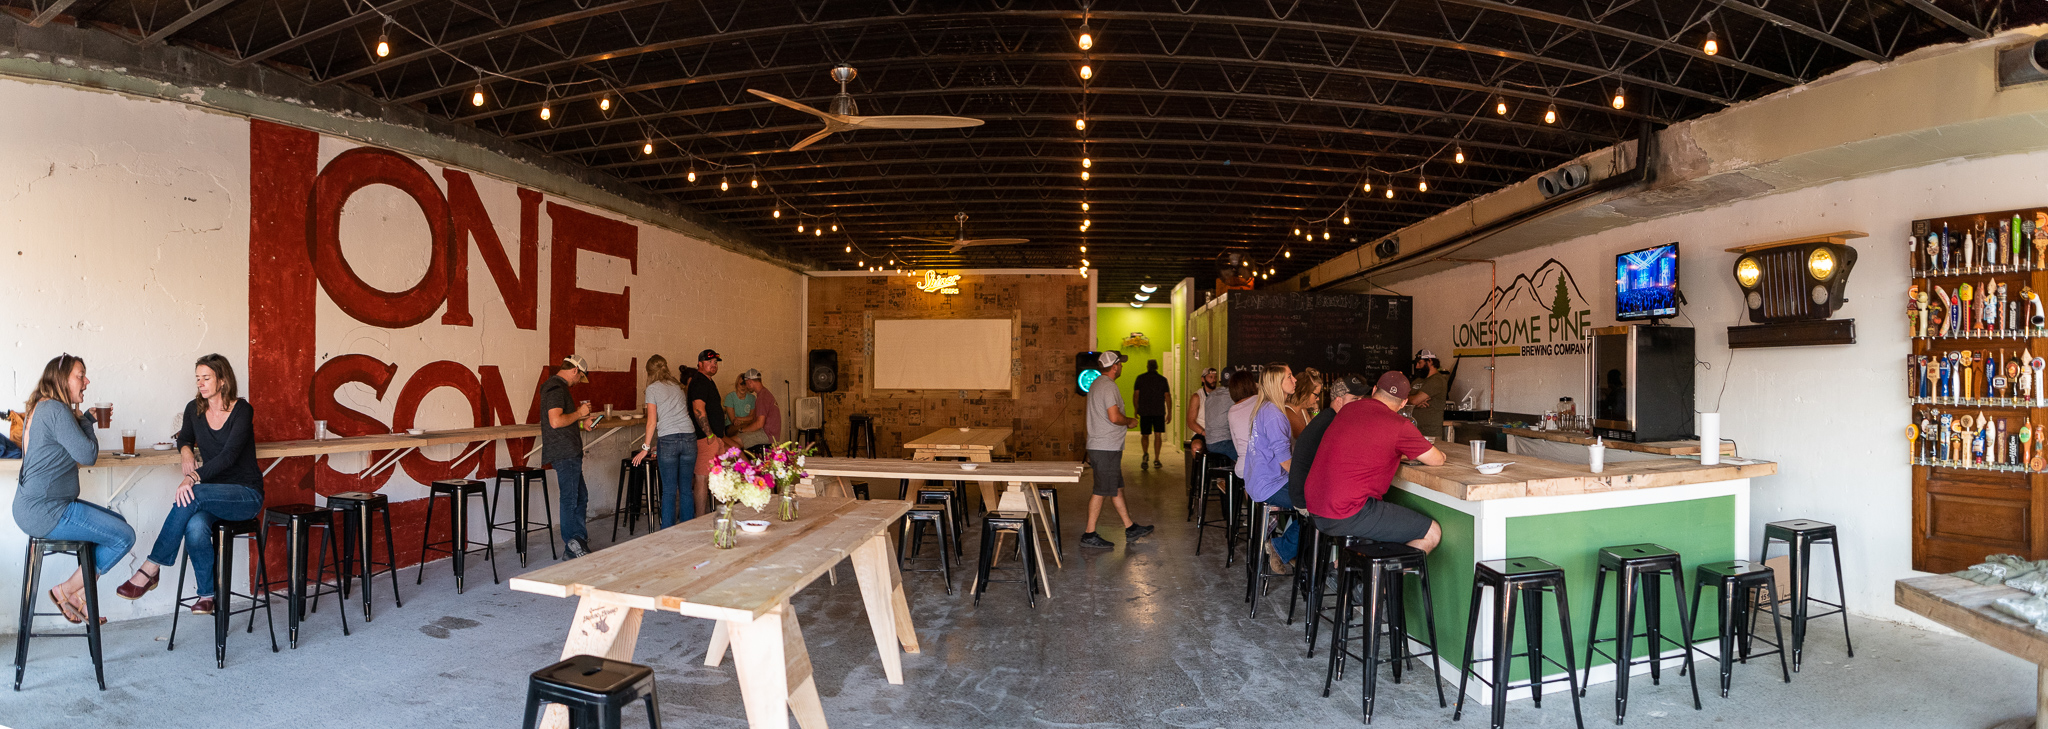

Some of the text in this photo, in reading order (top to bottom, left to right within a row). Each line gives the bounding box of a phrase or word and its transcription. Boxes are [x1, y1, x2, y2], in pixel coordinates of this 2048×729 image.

[916, 269, 962, 291] Shiner
[1453, 309, 1591, 348] LONESOME PINE
[1326, 343, 1352, 365] $5
[1521, 343, 1592, 357] BREWING COMPANY
